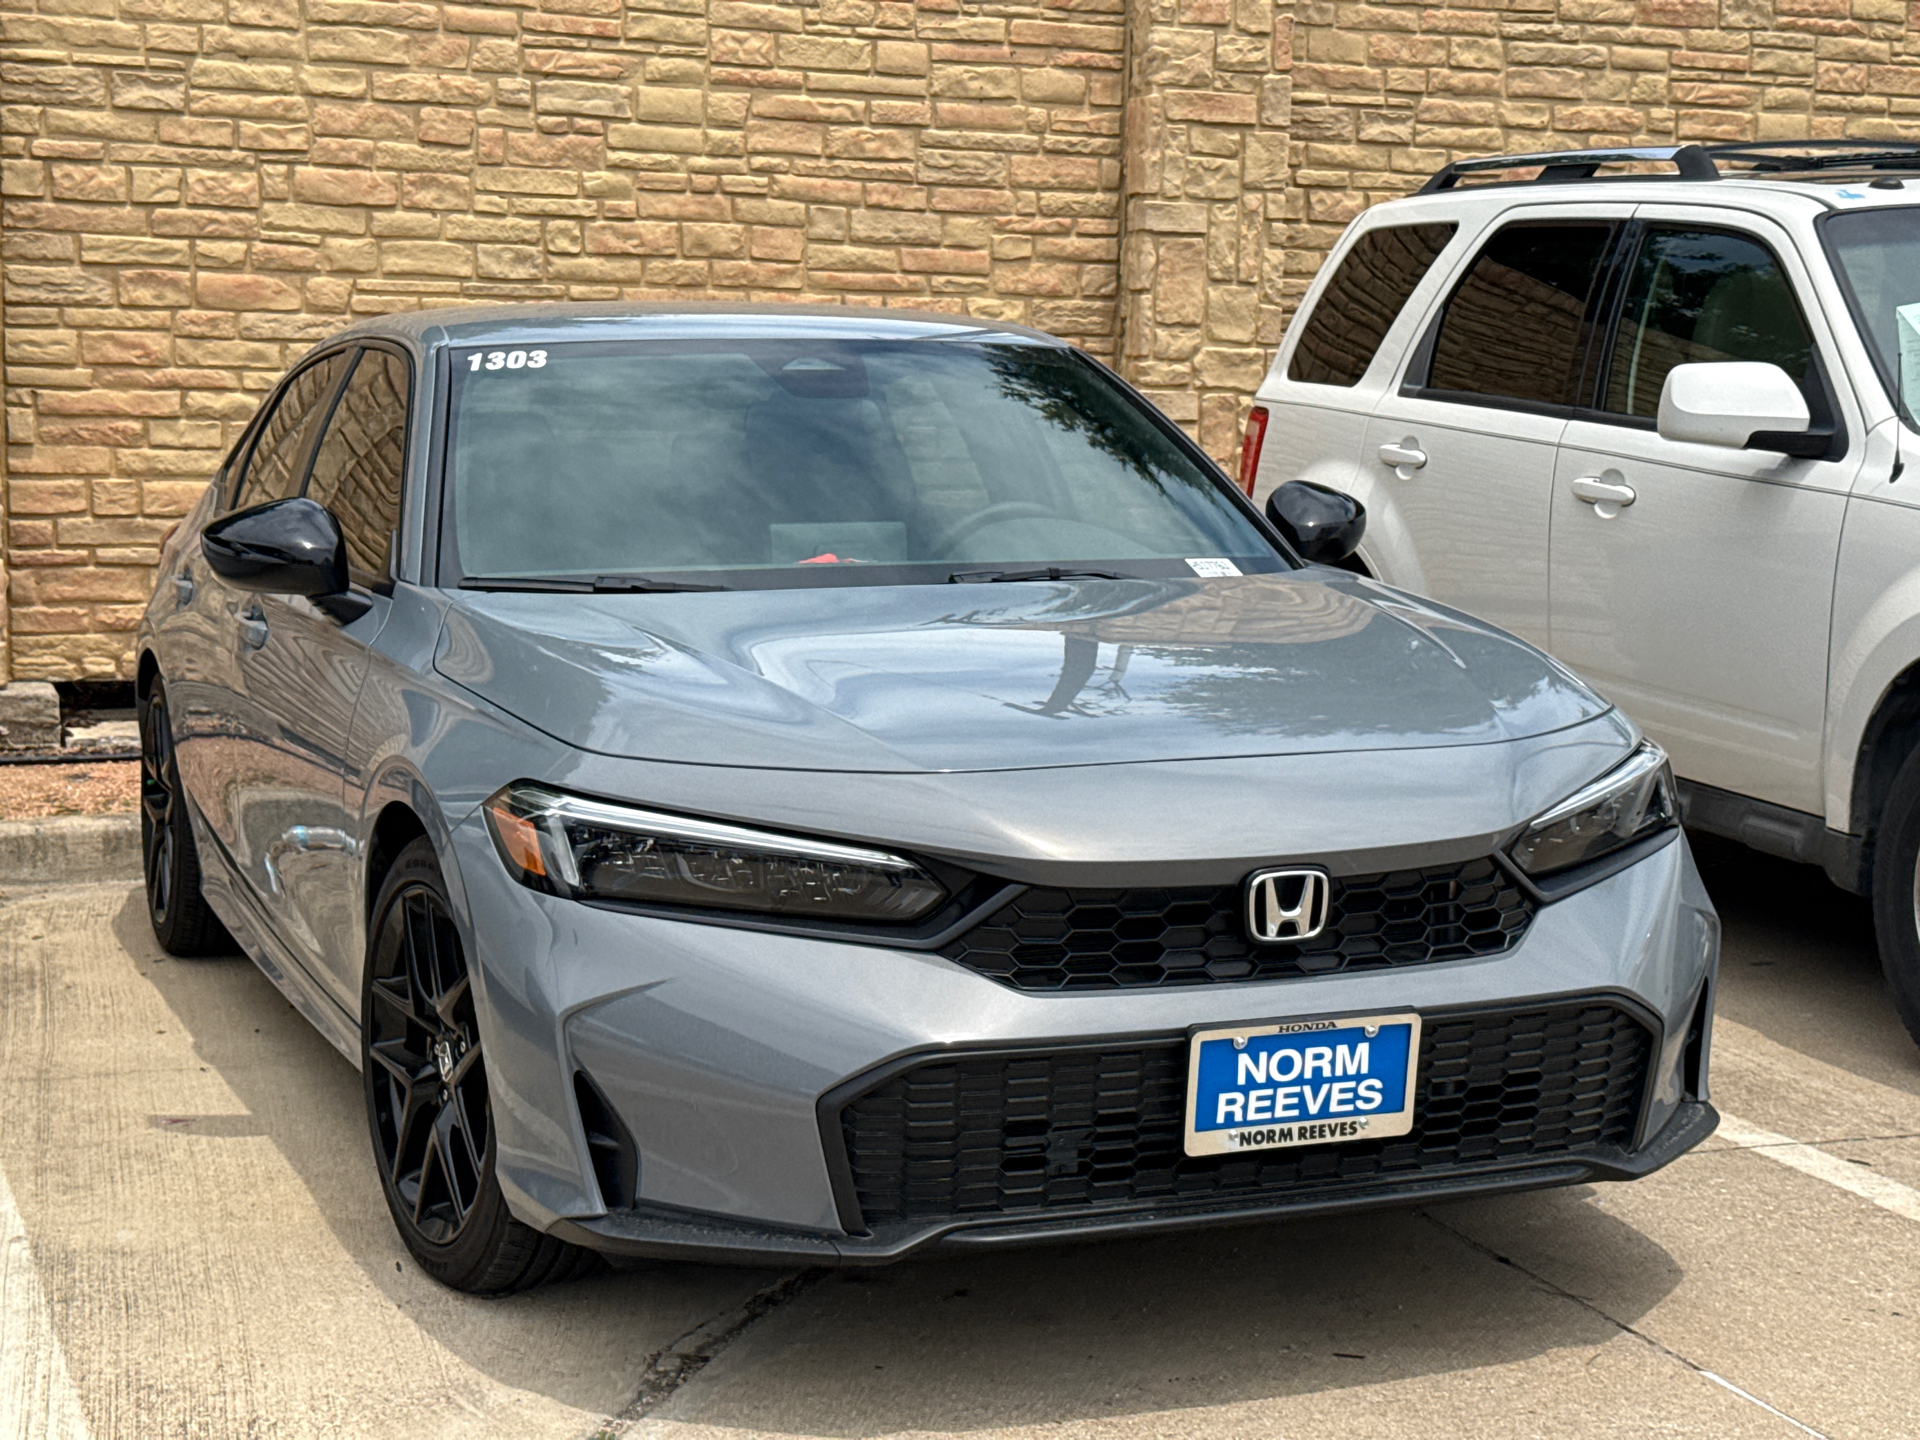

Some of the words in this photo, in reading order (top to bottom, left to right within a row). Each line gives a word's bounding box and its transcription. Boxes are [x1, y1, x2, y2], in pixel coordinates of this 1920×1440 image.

[467, 349, 548, 372] 1303
[1278, 1021, 1338, 1034] HONDA
[1237, 1042, 1370, 1086] NORM
[1216, 1078, 1384, 1124] REEVES
[1239, 1127, 1293, 1147] NORM
[1298, 1121, 1358, 1141] REEVES
